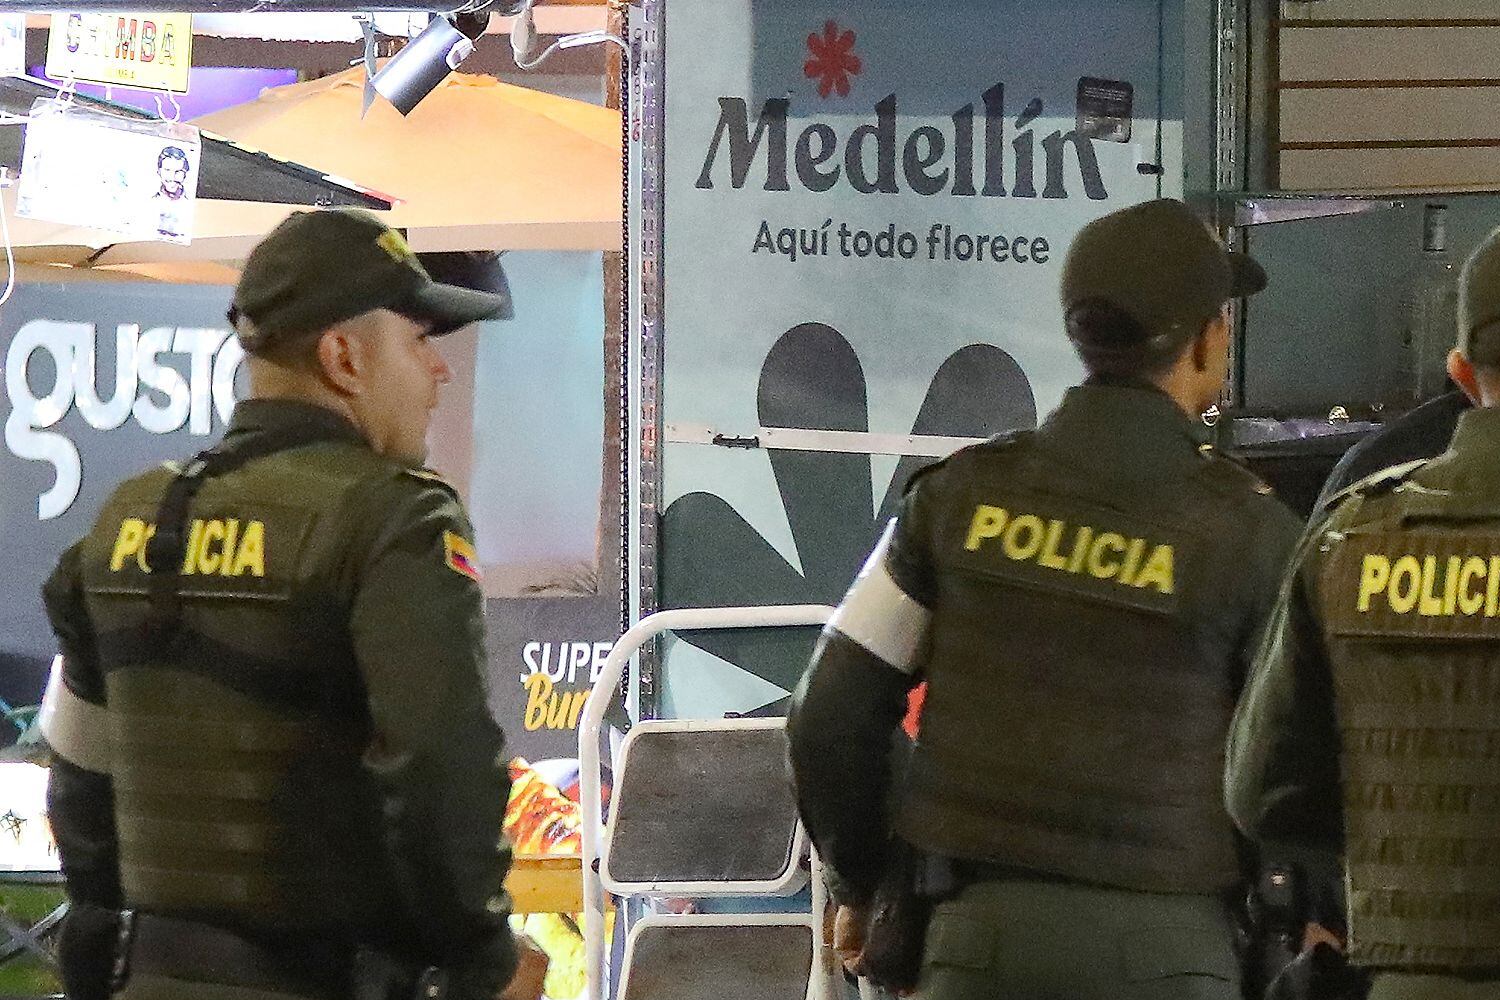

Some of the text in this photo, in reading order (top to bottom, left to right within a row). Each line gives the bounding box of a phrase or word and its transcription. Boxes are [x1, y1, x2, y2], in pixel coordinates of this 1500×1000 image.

[695, 82, 1108, 200] Medellín
[752, 219, 1051, 265] Aquí todo florece
[109, 517, 265, 577] PICIA
[963, 504, 1175, 595] POLICIA
